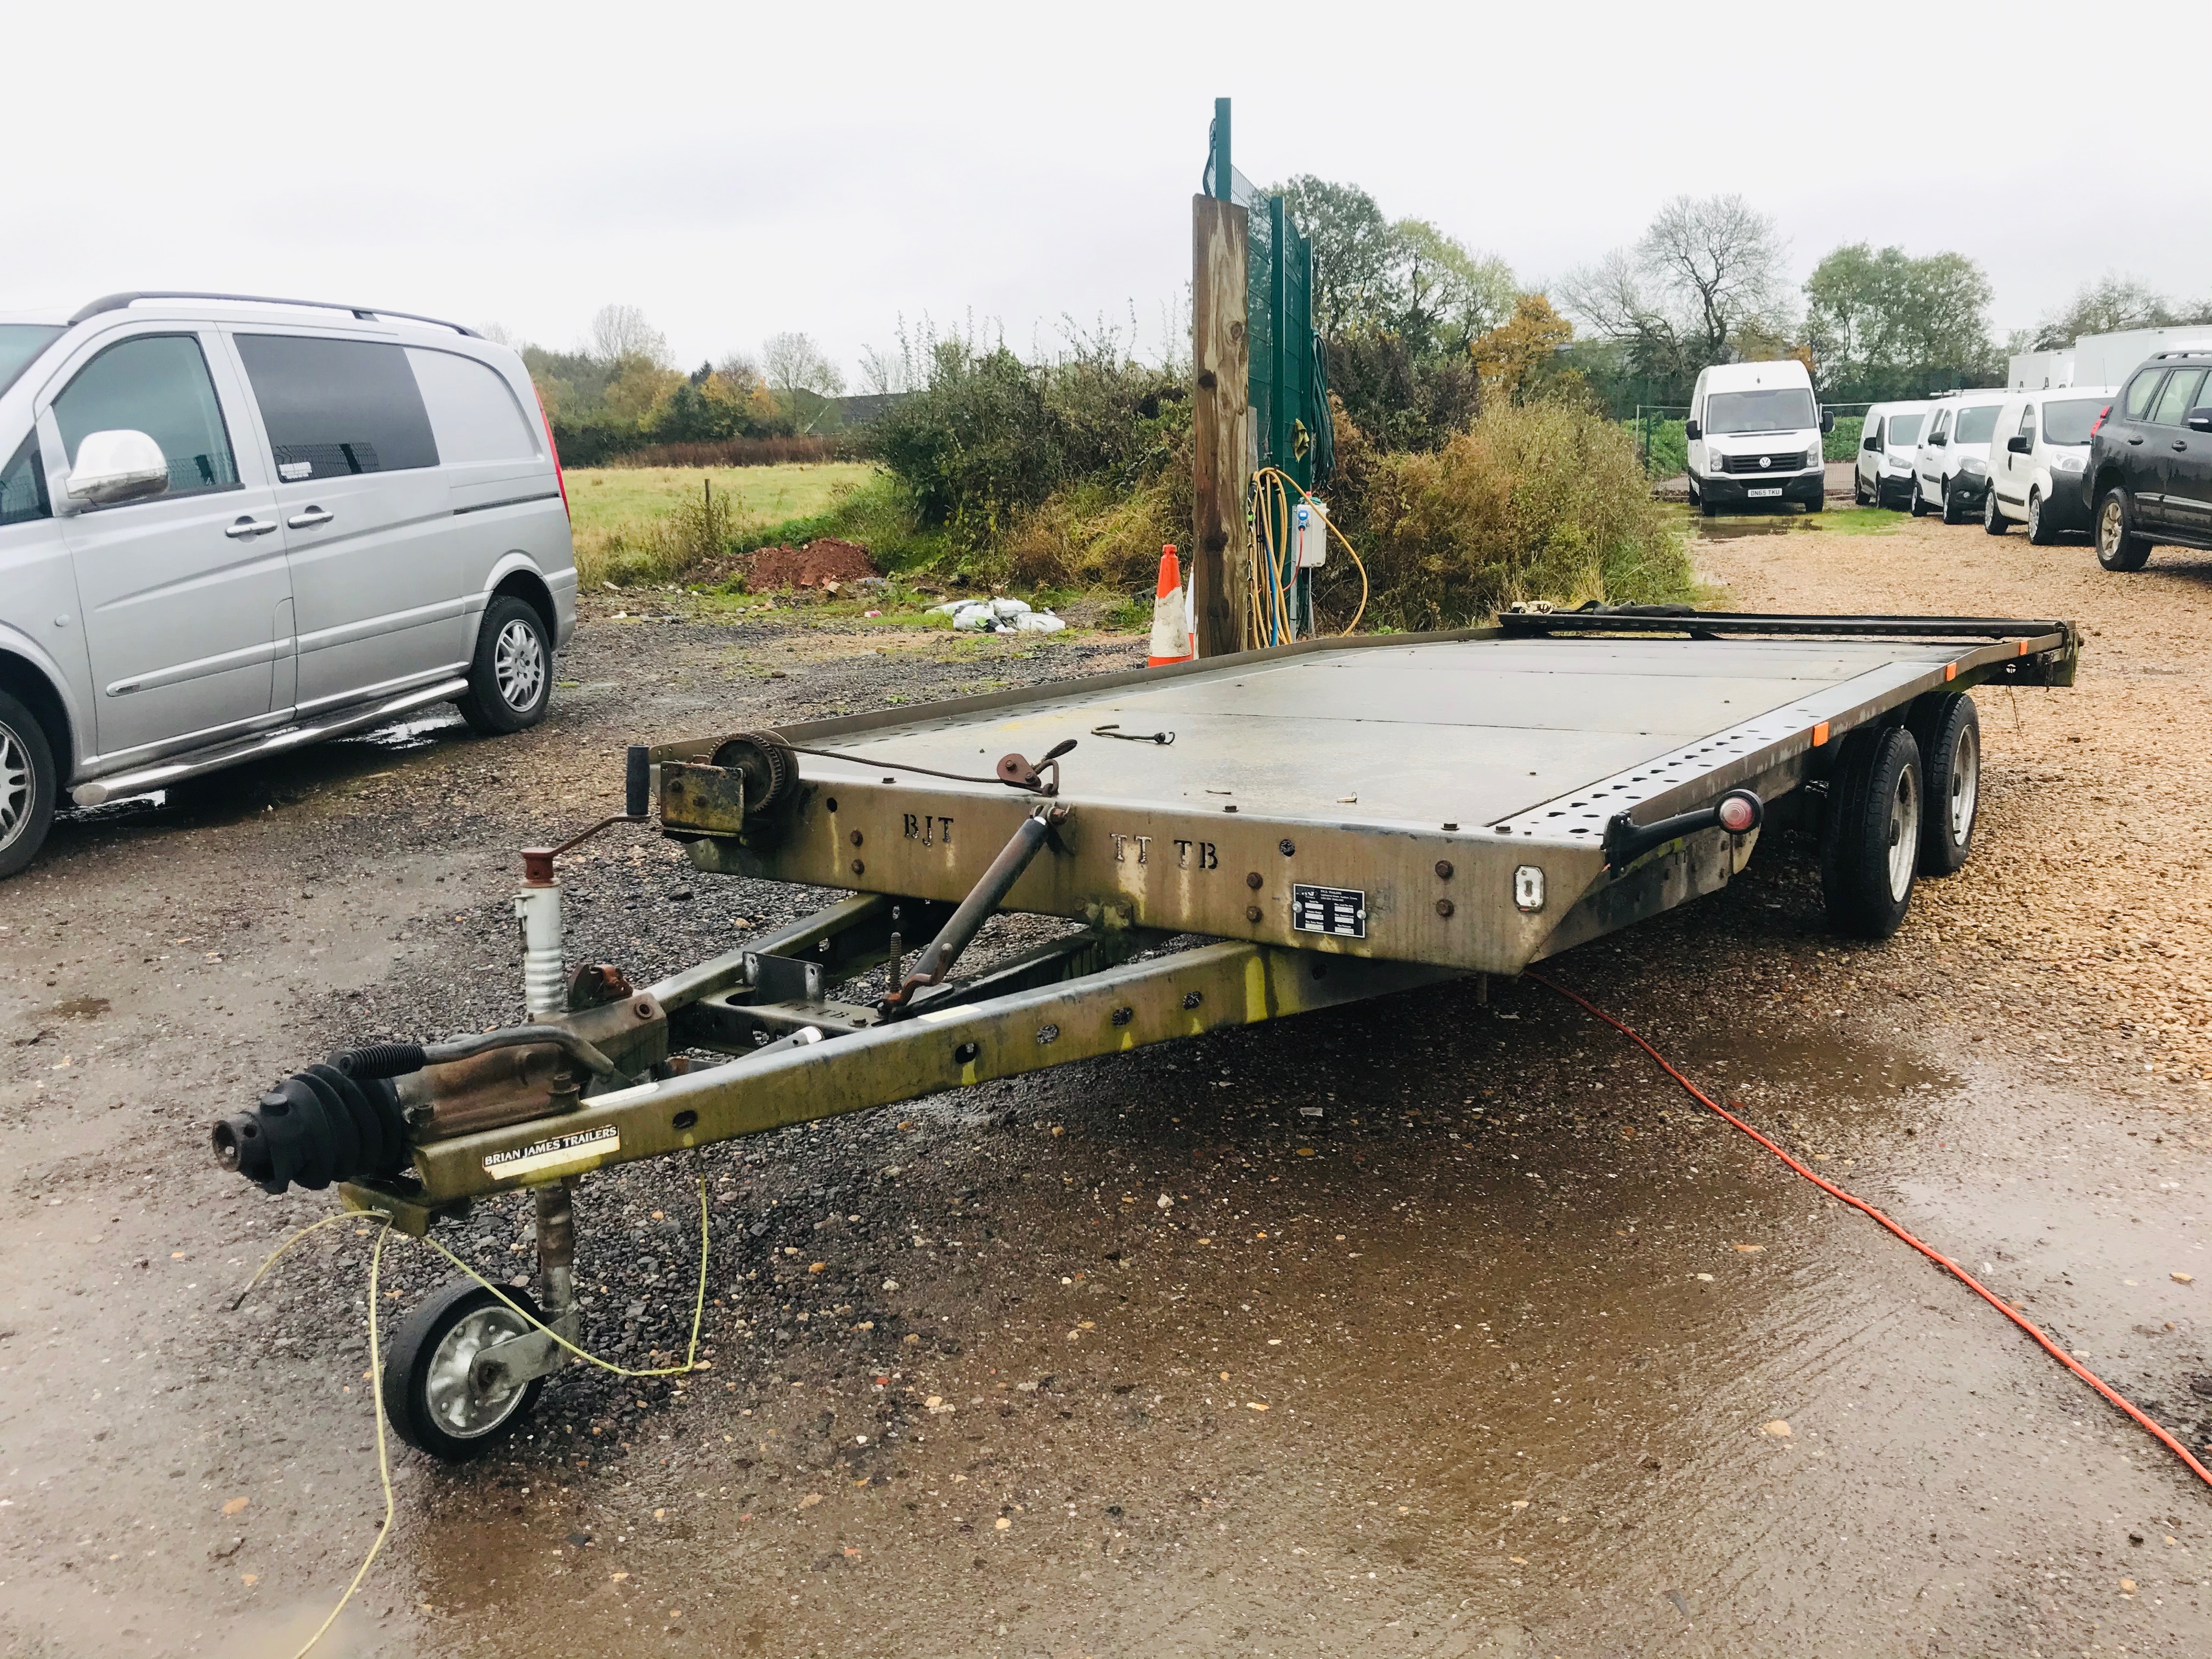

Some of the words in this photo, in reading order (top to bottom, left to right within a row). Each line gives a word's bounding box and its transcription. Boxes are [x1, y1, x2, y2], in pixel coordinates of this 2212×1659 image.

[904, 814, 954, 846] BJT
[1109, 832, 1152, 864] TT
[1173, 839, 1218, 870] TB
[485, 1149, 521, 1165] BRIAN
[522, 1139, 561, 1158] JAMES
[563, 1127, 617, 1147] TRAILERS
